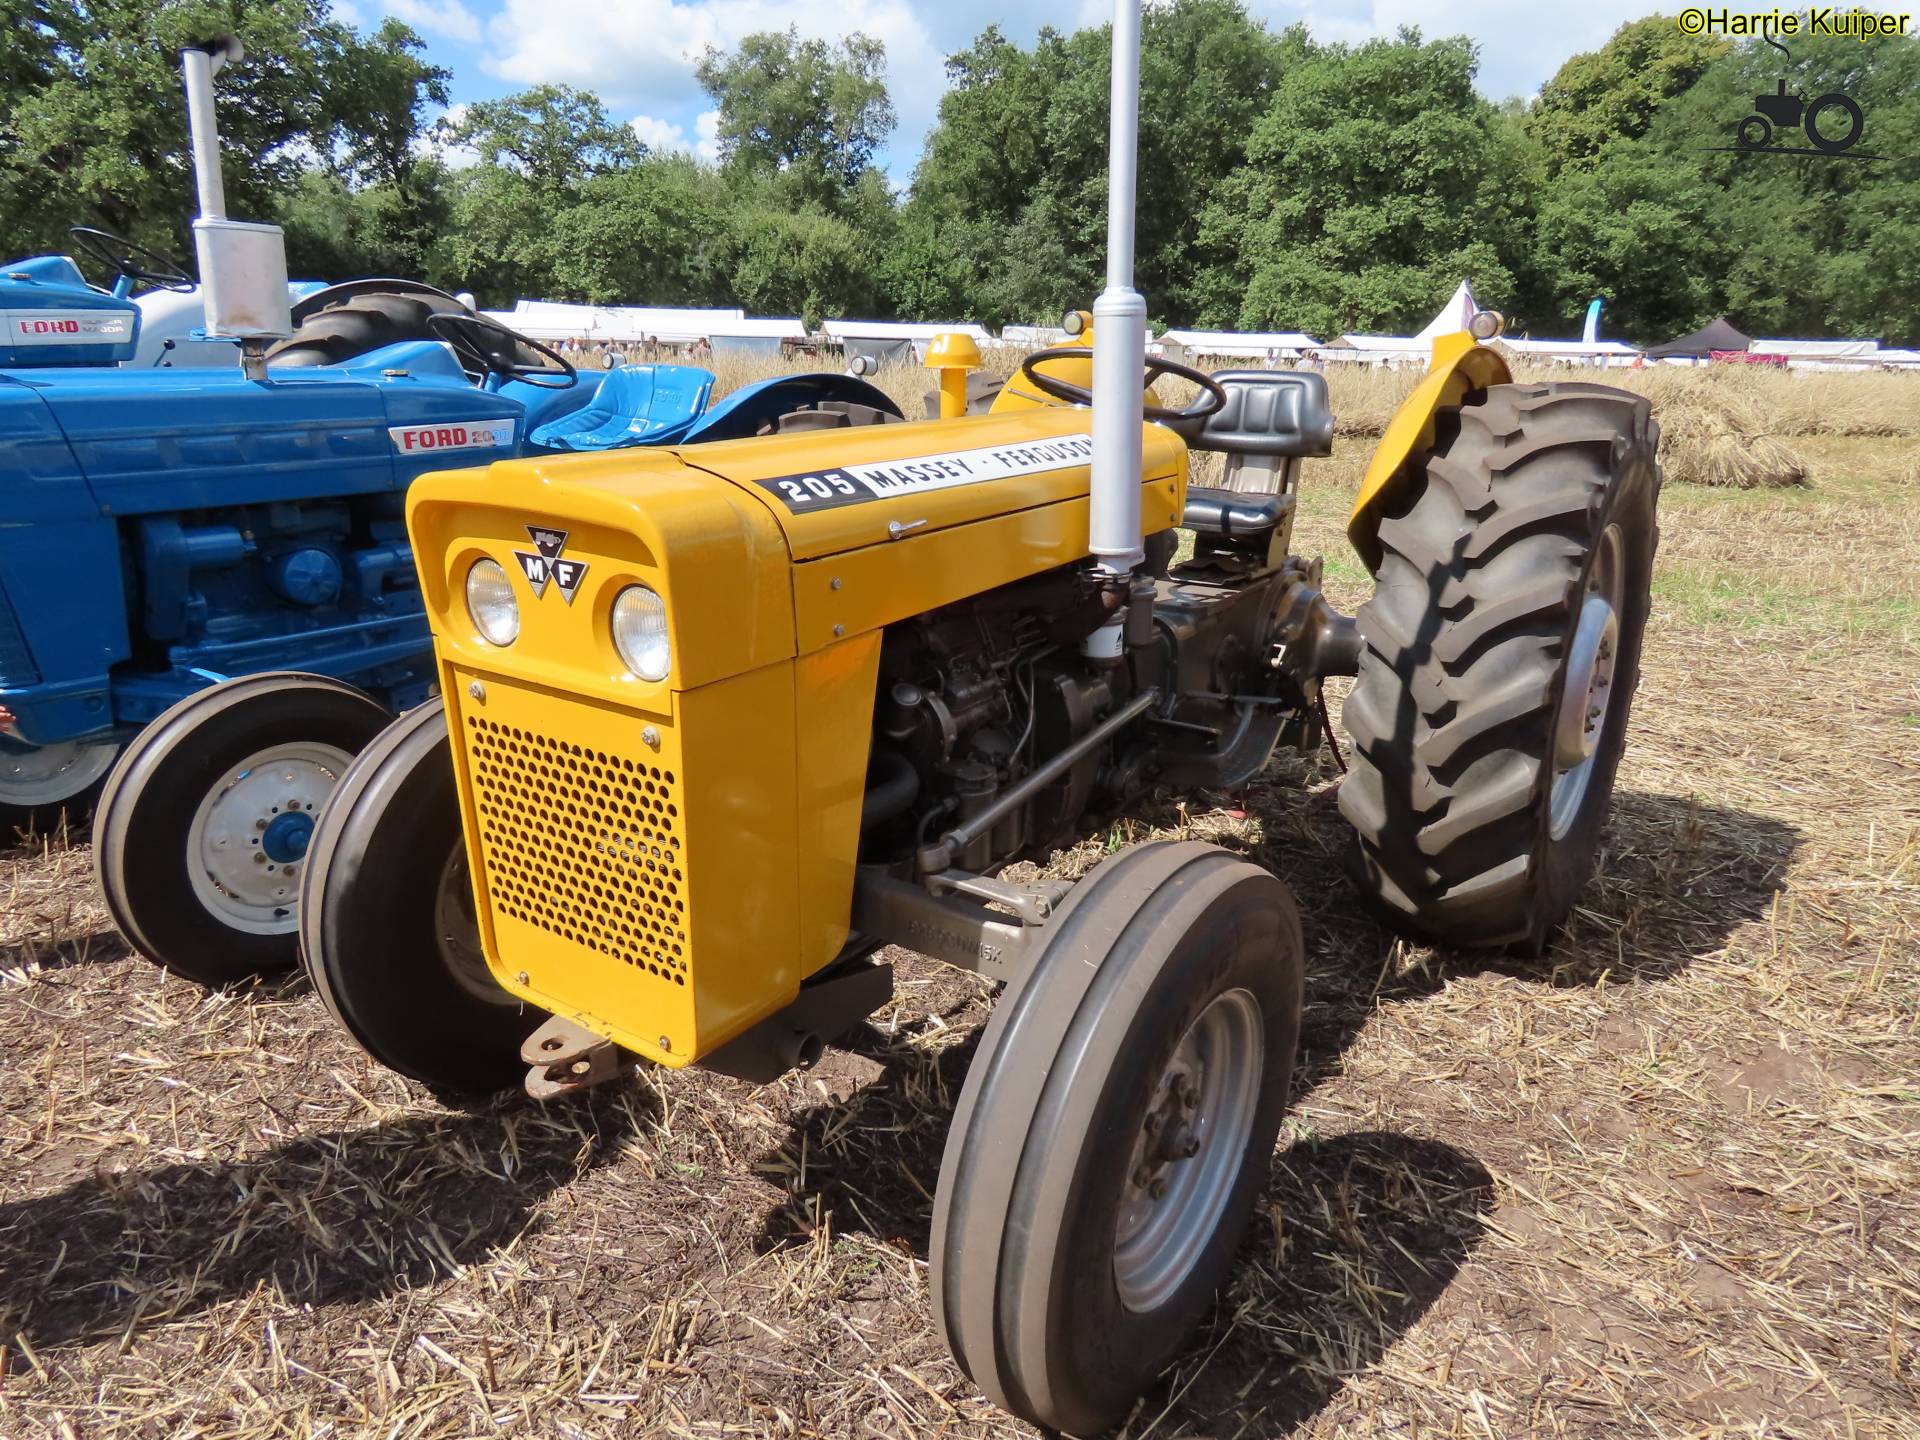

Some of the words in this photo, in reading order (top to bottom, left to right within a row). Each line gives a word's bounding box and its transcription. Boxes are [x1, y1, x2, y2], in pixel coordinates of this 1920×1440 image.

[20, 320, 79, 333] FORD
[403, 427, 468, 450] FORD
[778, 474, 856, 502] 205
[864, 458, 973, 488] MASSEY
